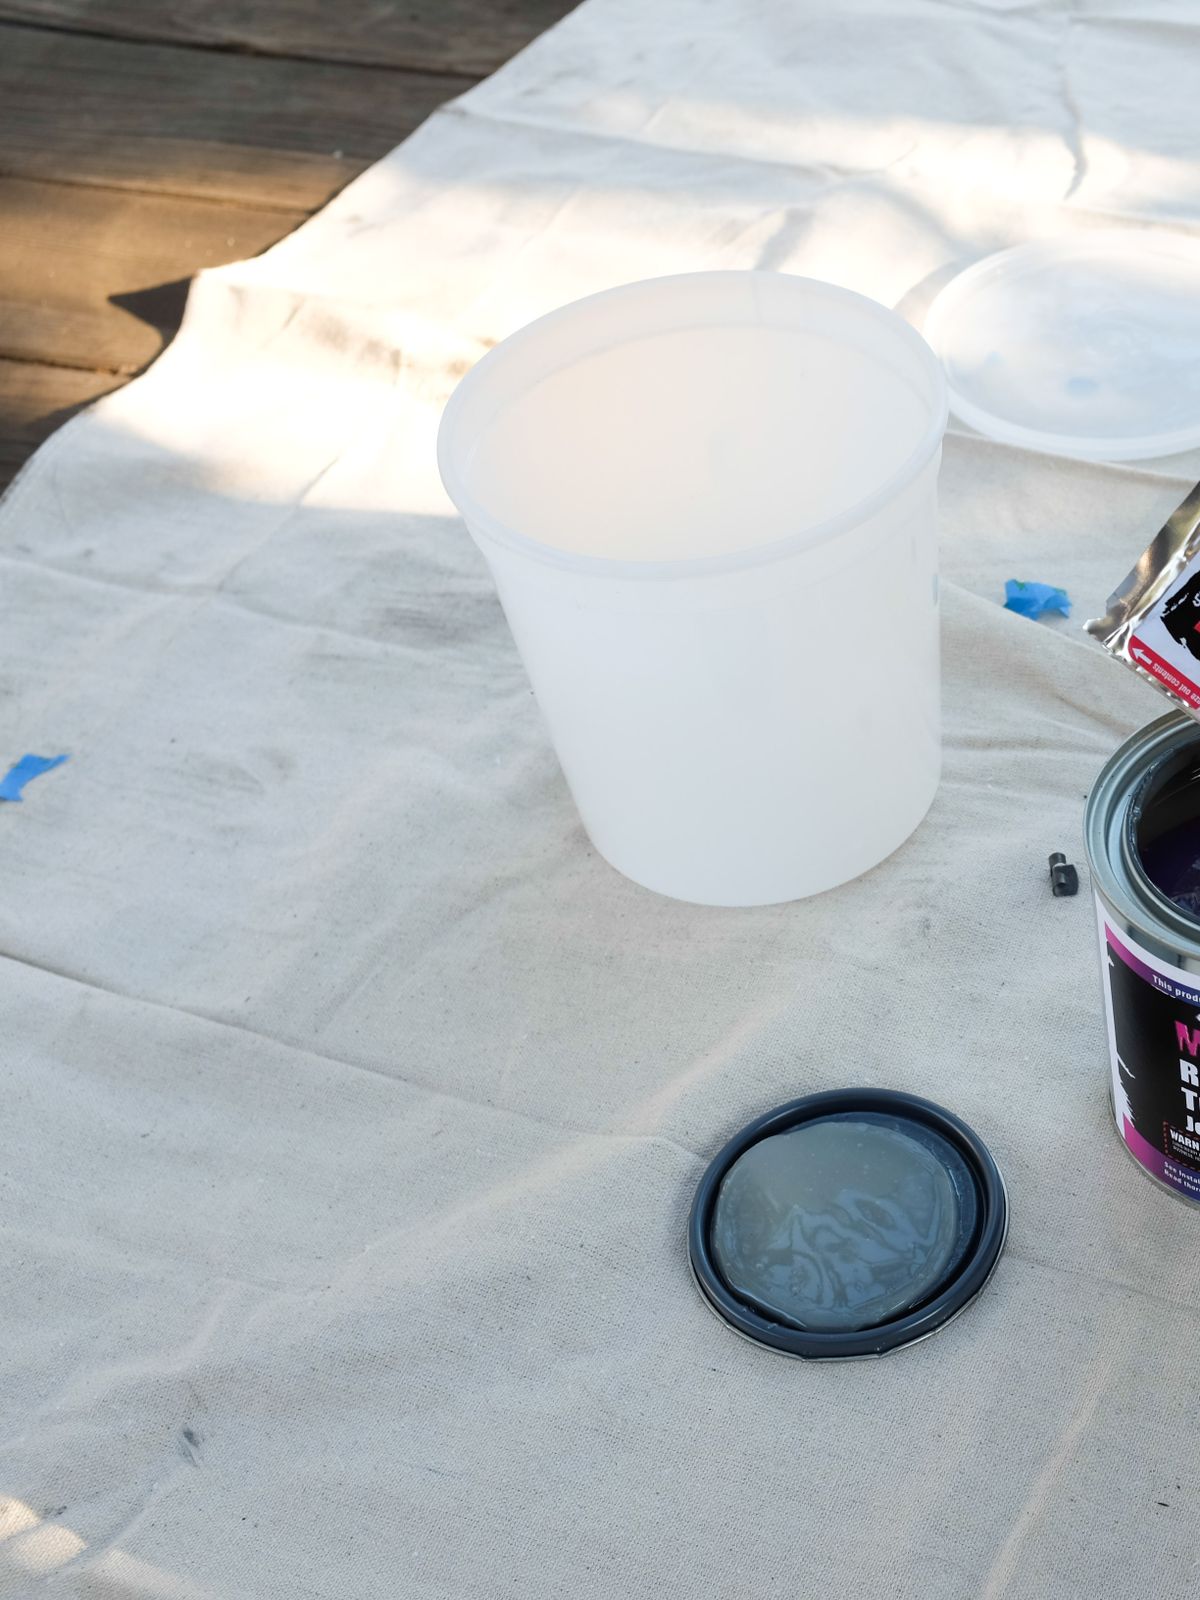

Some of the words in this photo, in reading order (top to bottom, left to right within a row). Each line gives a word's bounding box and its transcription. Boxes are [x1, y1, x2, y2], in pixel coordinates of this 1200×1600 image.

[1151, 662, 1180, 687] contents
[1177, 682, 1191, 695] out
[1152, 974, 1172, 992] This
